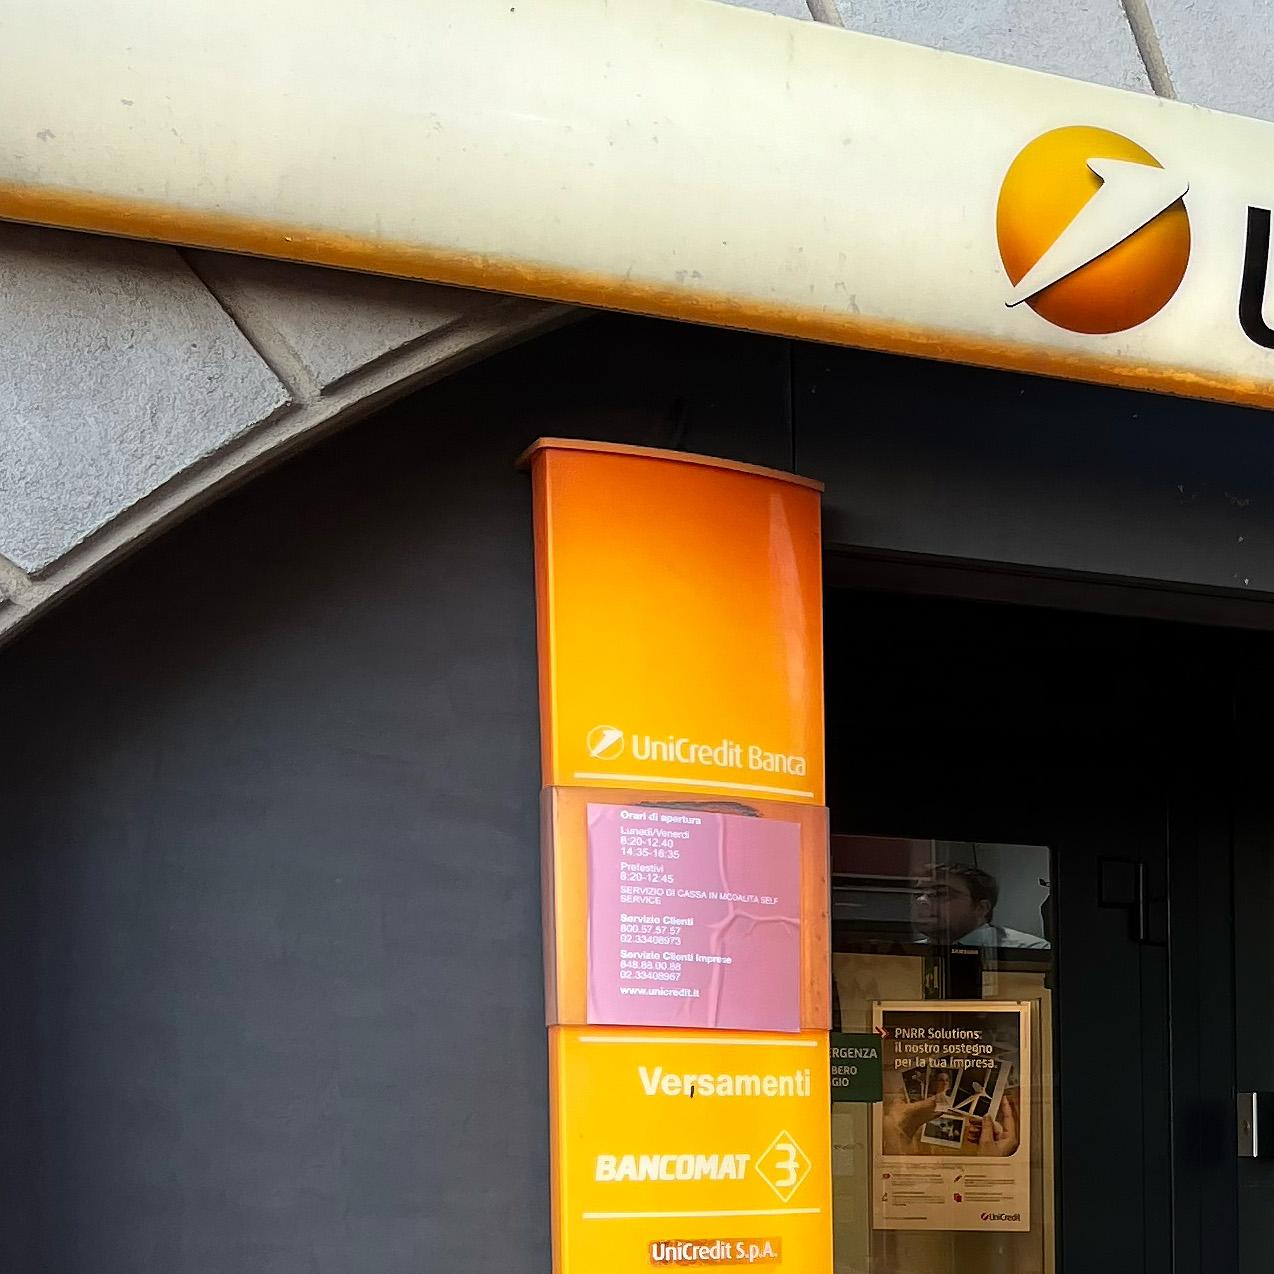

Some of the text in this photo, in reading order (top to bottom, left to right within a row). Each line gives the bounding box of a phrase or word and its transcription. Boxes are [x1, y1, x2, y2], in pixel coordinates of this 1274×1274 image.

[631, 733, 807, 777] UniCredit Banca
[620, 810, 703, 825] Orari di apertura
[620, 886, 665, 897] SERVIZIO
[677, 890, 707, 899] CASSA
[620, 894, 662, 905] SERVICE
[620, 913, 694, 926] Servizio Clienti
[894, 1026, 983, 1040] PNRR Solutions:
[829, 1047, 878, 1059] RGENZA
[904, 1043, 940, 1054] nostro
[942, 1043, 994, 1057] sostegno
[831, 1065, 858, 1076] BERO
[894, 1059, 913, 1070] per
[915, 1057, 926, 1068] la
[929, 1058, 947, 1068] tua
[637, 1065, 812, 1098] Versamenti
[593, 1153, 752, 1182] BANCOMAT
[651, 1239, 778, 1263] UniCredit S.p.A.
